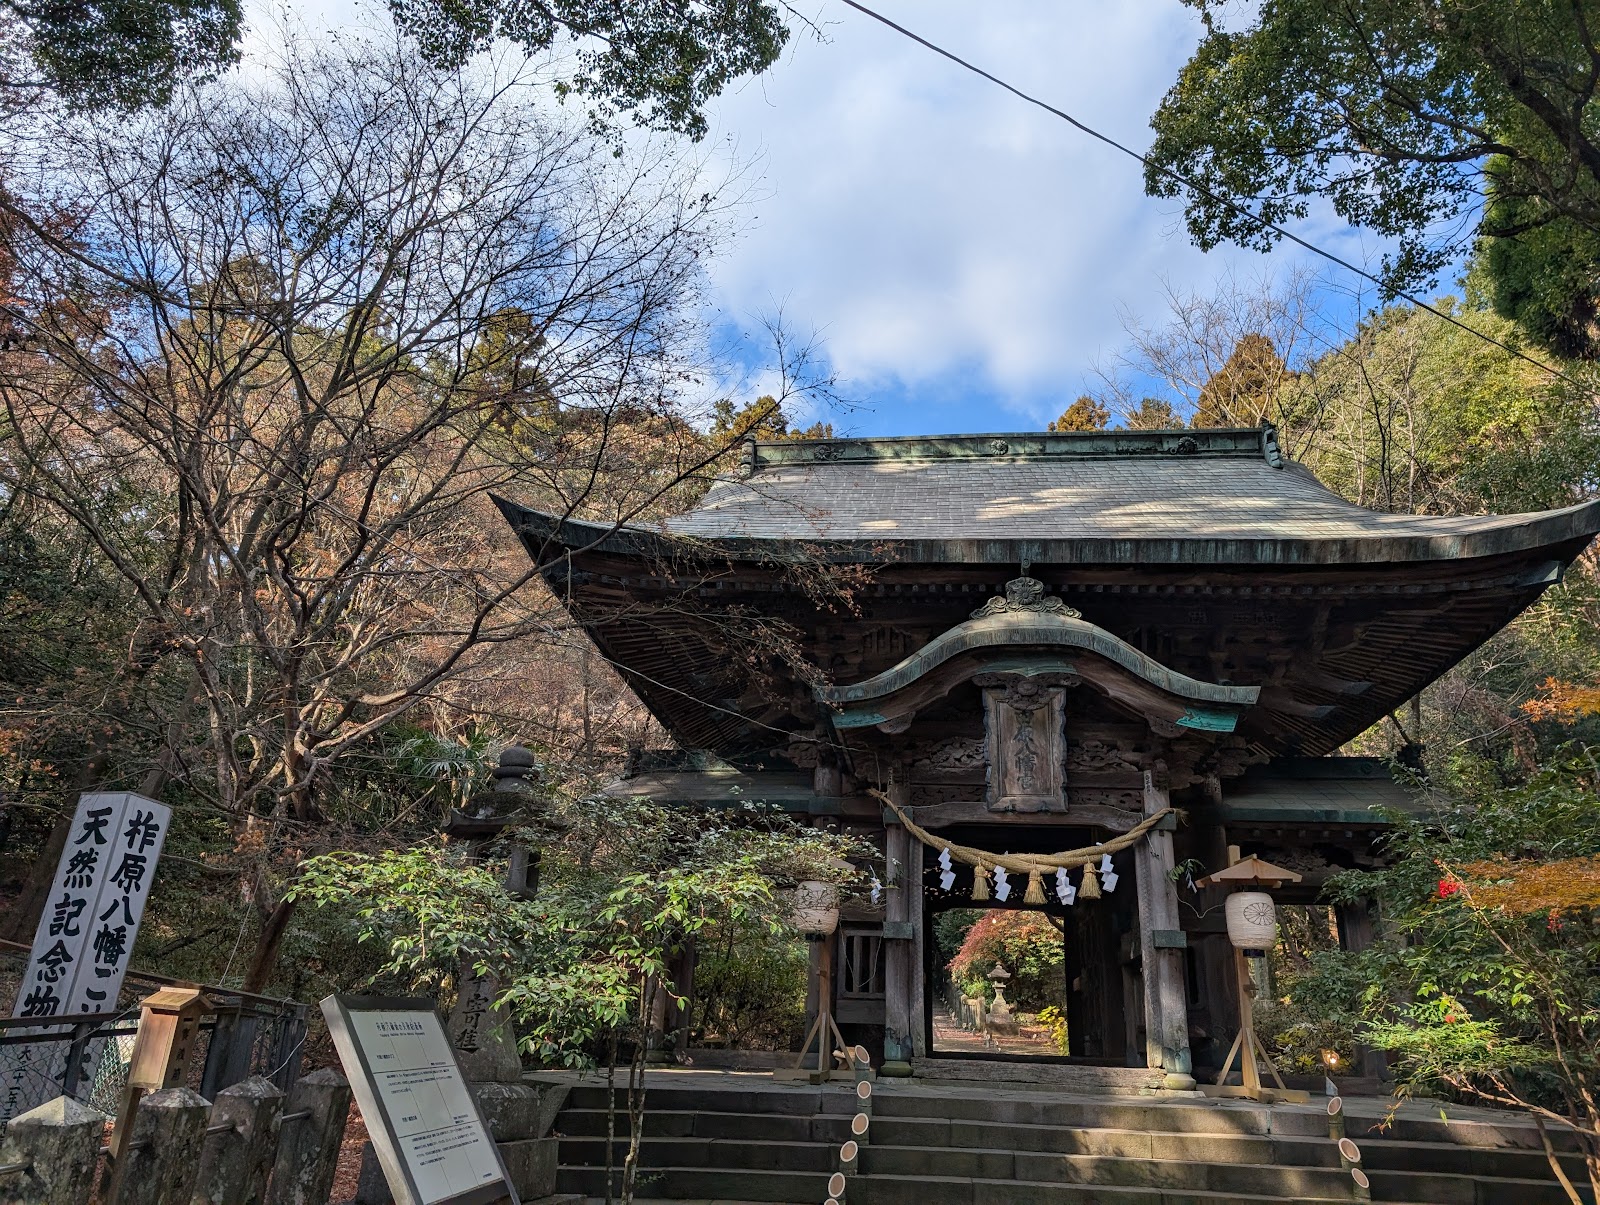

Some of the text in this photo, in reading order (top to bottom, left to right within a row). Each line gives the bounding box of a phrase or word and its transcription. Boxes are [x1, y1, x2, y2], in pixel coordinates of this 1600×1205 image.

[19, 806, 113, 1029] 天然記念物
[55, 809, 160, 1082] 柞原八幡ご
